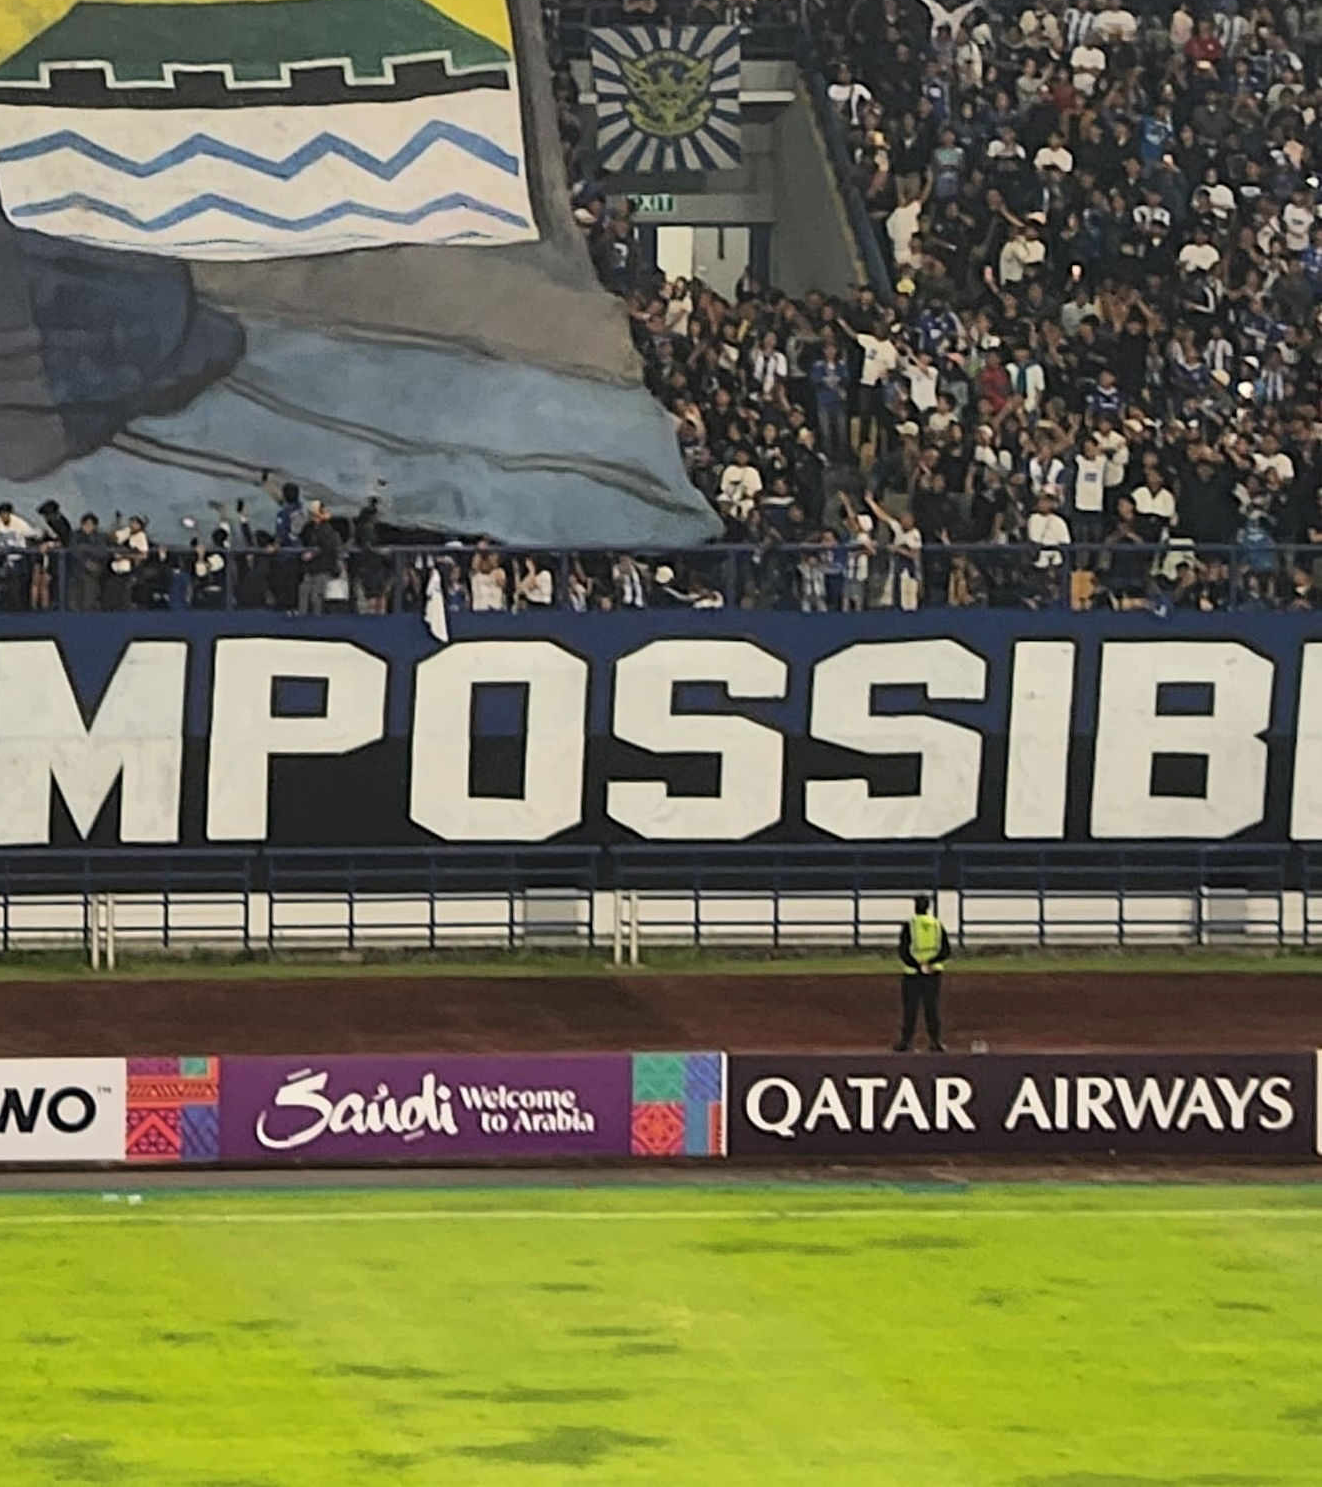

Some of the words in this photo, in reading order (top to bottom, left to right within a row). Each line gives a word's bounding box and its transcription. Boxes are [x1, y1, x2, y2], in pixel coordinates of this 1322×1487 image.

[459, 1085, 576, 1111] Welcome
[746, 1077, 977, 1139] QATAR
[1005, 1076, 1294, 1131] AIRWAYS
[481, 1110, 507, 1133] to
[513, 1106, 594, 1133] Arabia
